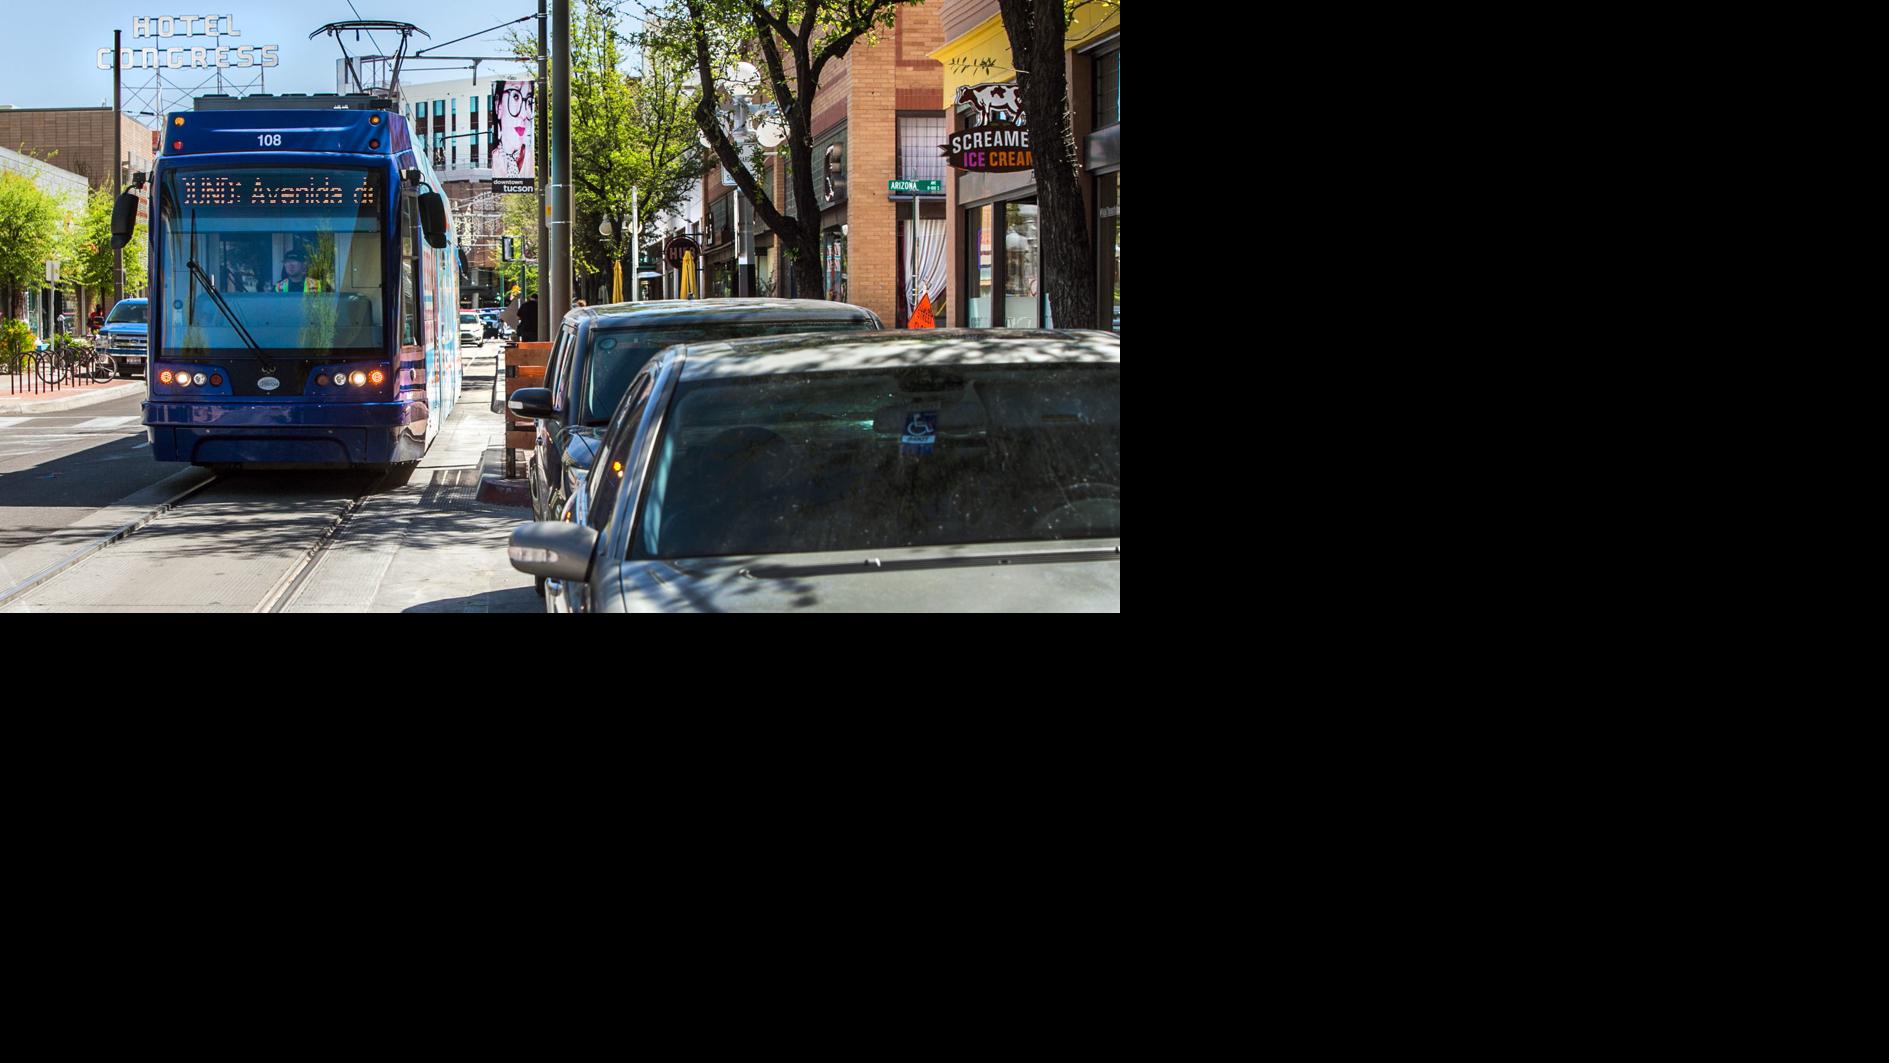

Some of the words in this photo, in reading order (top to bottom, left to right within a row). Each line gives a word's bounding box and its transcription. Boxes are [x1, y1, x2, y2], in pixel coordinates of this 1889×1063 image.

[133, 14, 241, 38] HOTEL
[97, 45, 279, 69] CONGRESS
[257, 134, 282, 147] 108
[952, 131, 1029, 153] SCREAME
[963, 152, 986, 168] ICE
[251, 177, 343, 204] Avenida
[503, 184, 534, 193] tucson
[890, 181, 917, 190] ARIZONA
